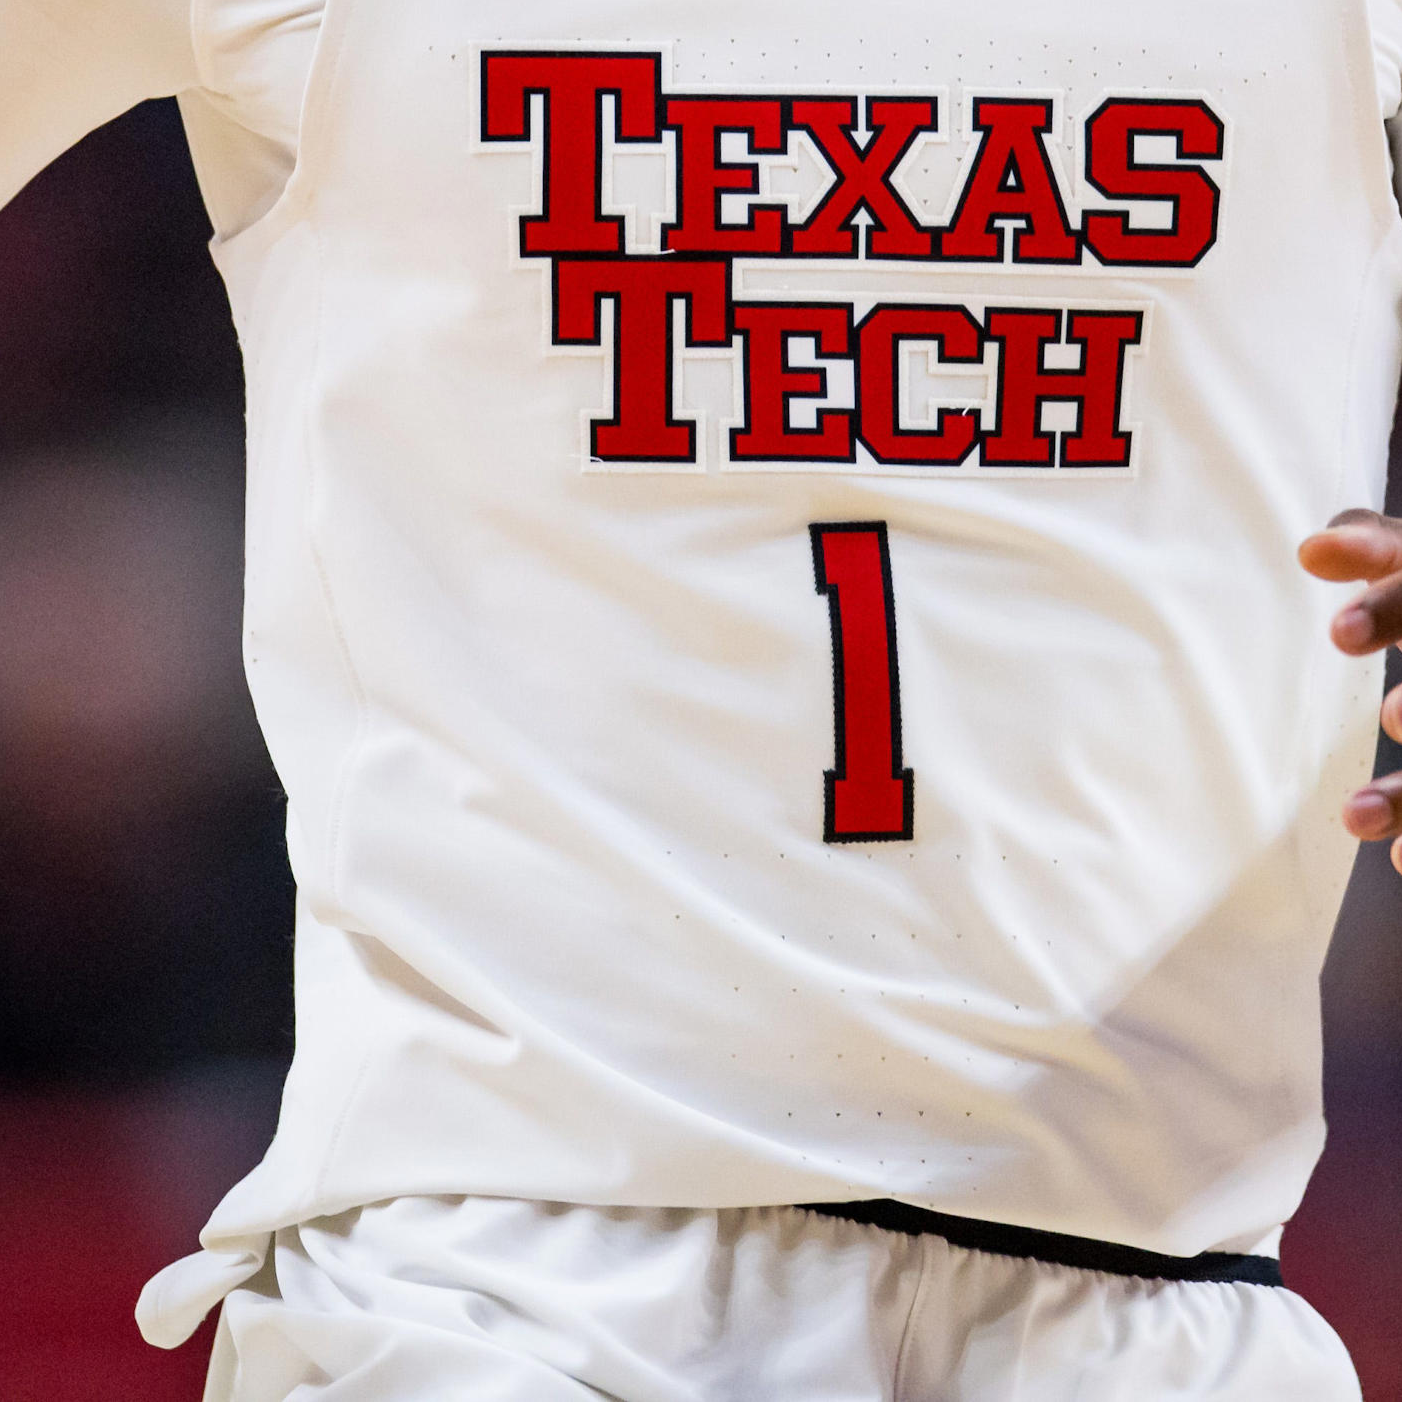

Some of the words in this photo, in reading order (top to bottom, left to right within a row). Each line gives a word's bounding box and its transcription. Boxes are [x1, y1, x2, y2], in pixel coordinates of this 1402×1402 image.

[479, 50, 1226, 269] TEXAS
[551, 256, 1145, 468] TECH
[808, 521, 915, 844] 1
